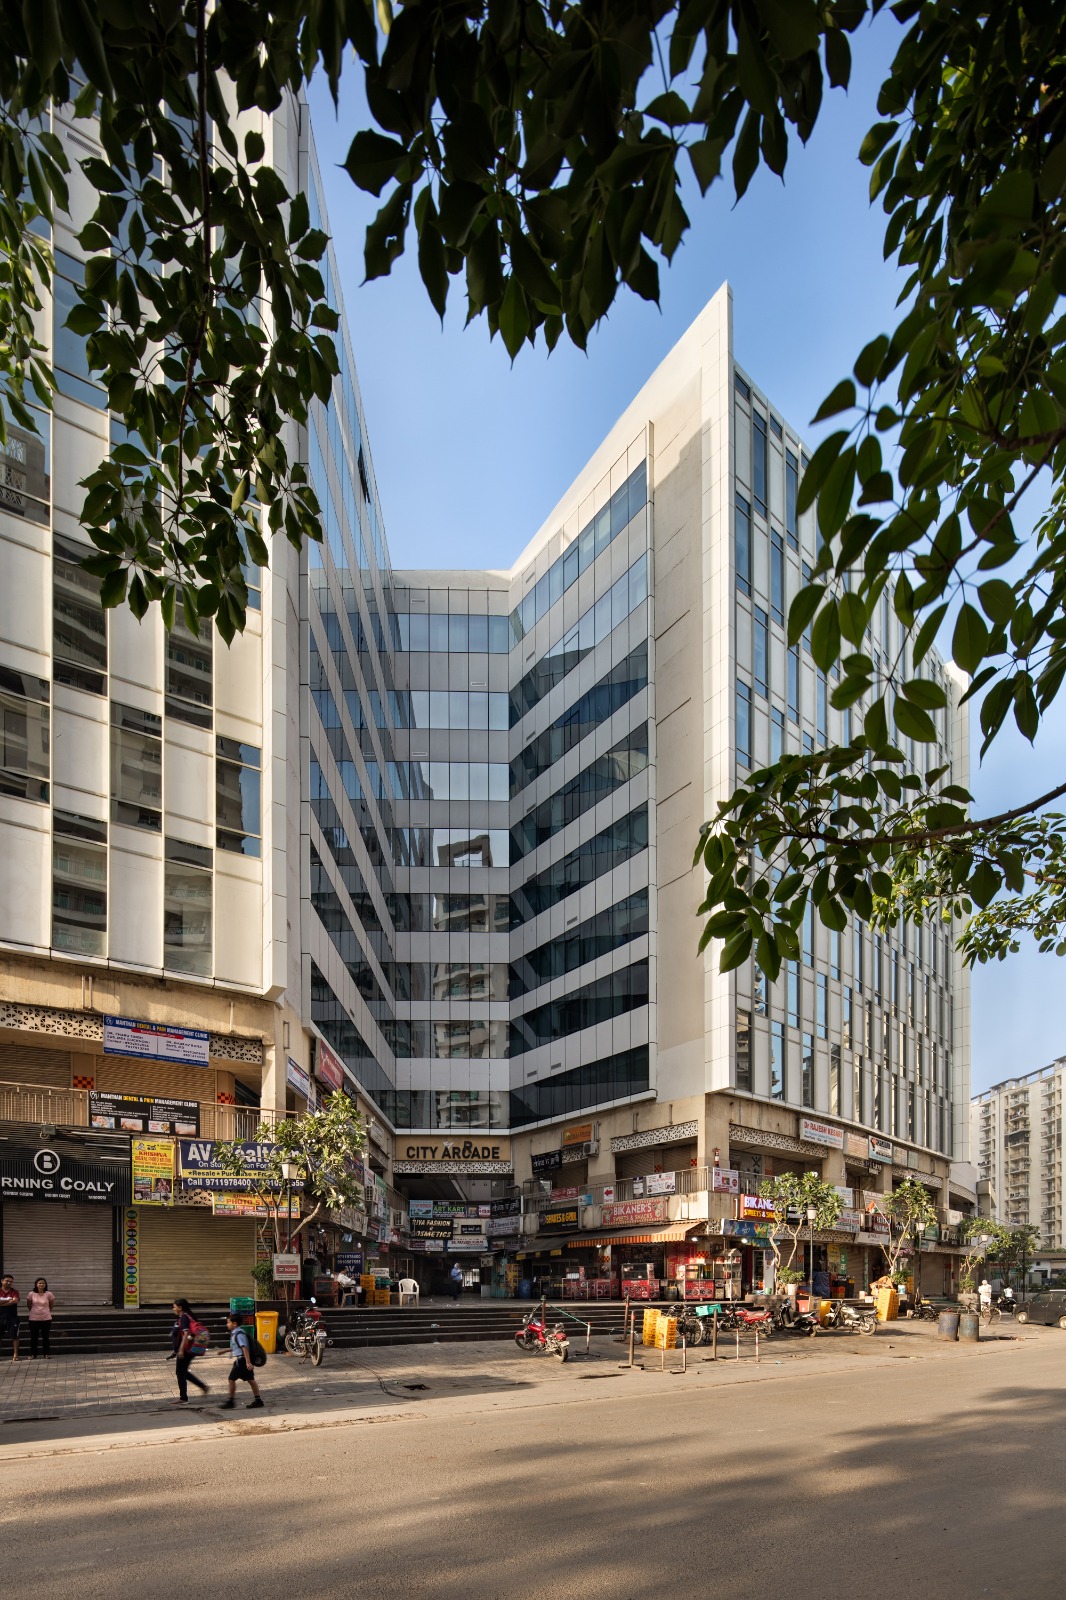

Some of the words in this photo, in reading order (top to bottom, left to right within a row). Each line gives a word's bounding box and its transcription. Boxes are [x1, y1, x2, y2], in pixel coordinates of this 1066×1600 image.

[810, 1123, 827, 1134] RAJESH
[188, 1144, 211, 1161] AV
[407, 1146, 438, 1159] CITY
[442, 1146, 500, 1159] ARCADE
[1, 1177, 54, 1189] RNING
[61, 1177, 114, 1192] COALY
[187, 1178, 202, 1186] Call
[613, 1203, 651, 1215] BIKANER'S
[744, 1196, 783, 1211] BIKANE
[744, 1209, 761, 1217] SWEETS
